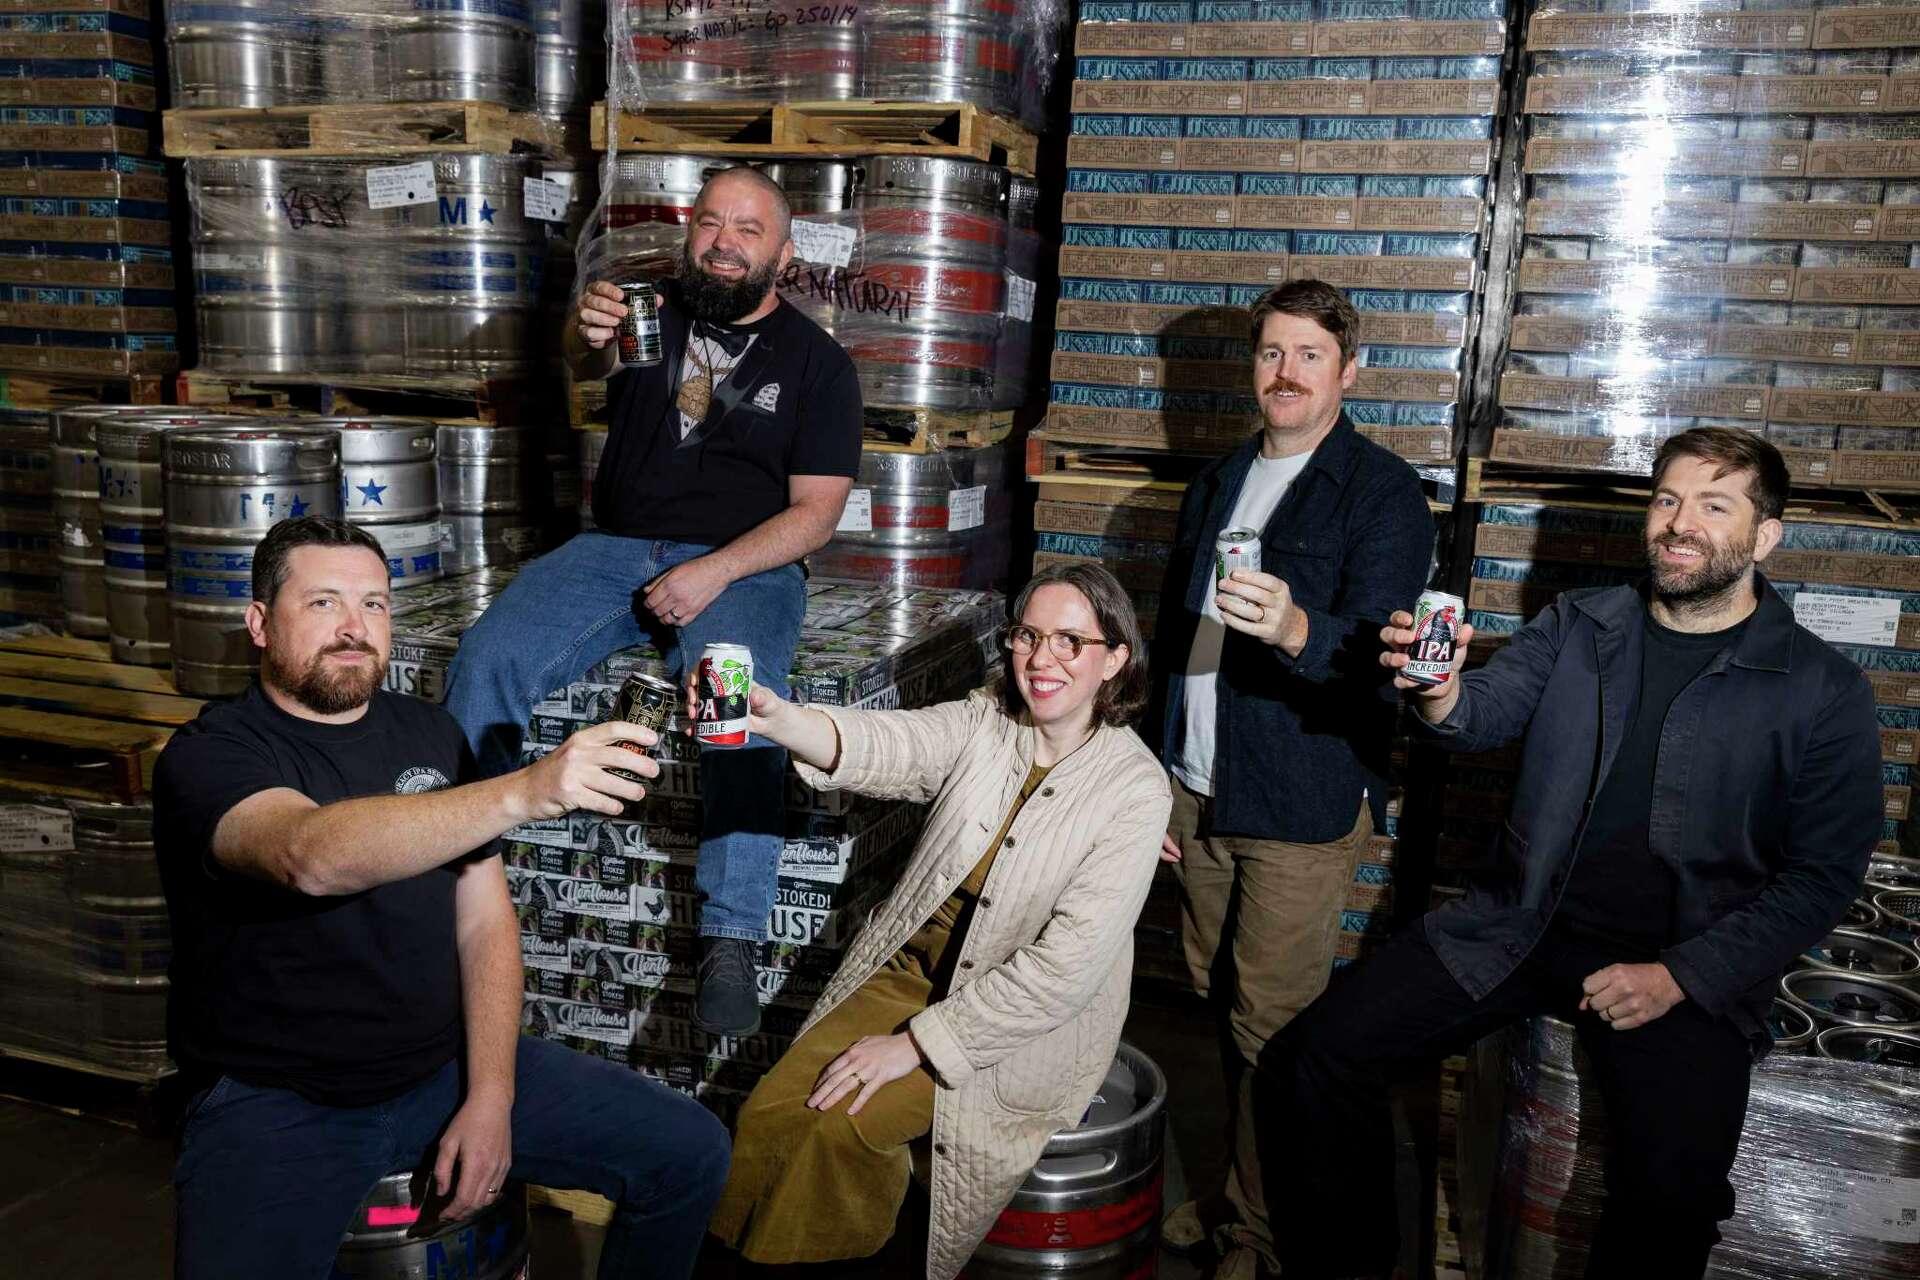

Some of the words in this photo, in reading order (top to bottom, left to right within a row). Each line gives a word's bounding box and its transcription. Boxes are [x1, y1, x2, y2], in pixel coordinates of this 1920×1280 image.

[1418, 640, 1451, 661] IPA
[1407, 661, 1452, 673] INCREDIBL
[622, 742, 646, 756] FORT
